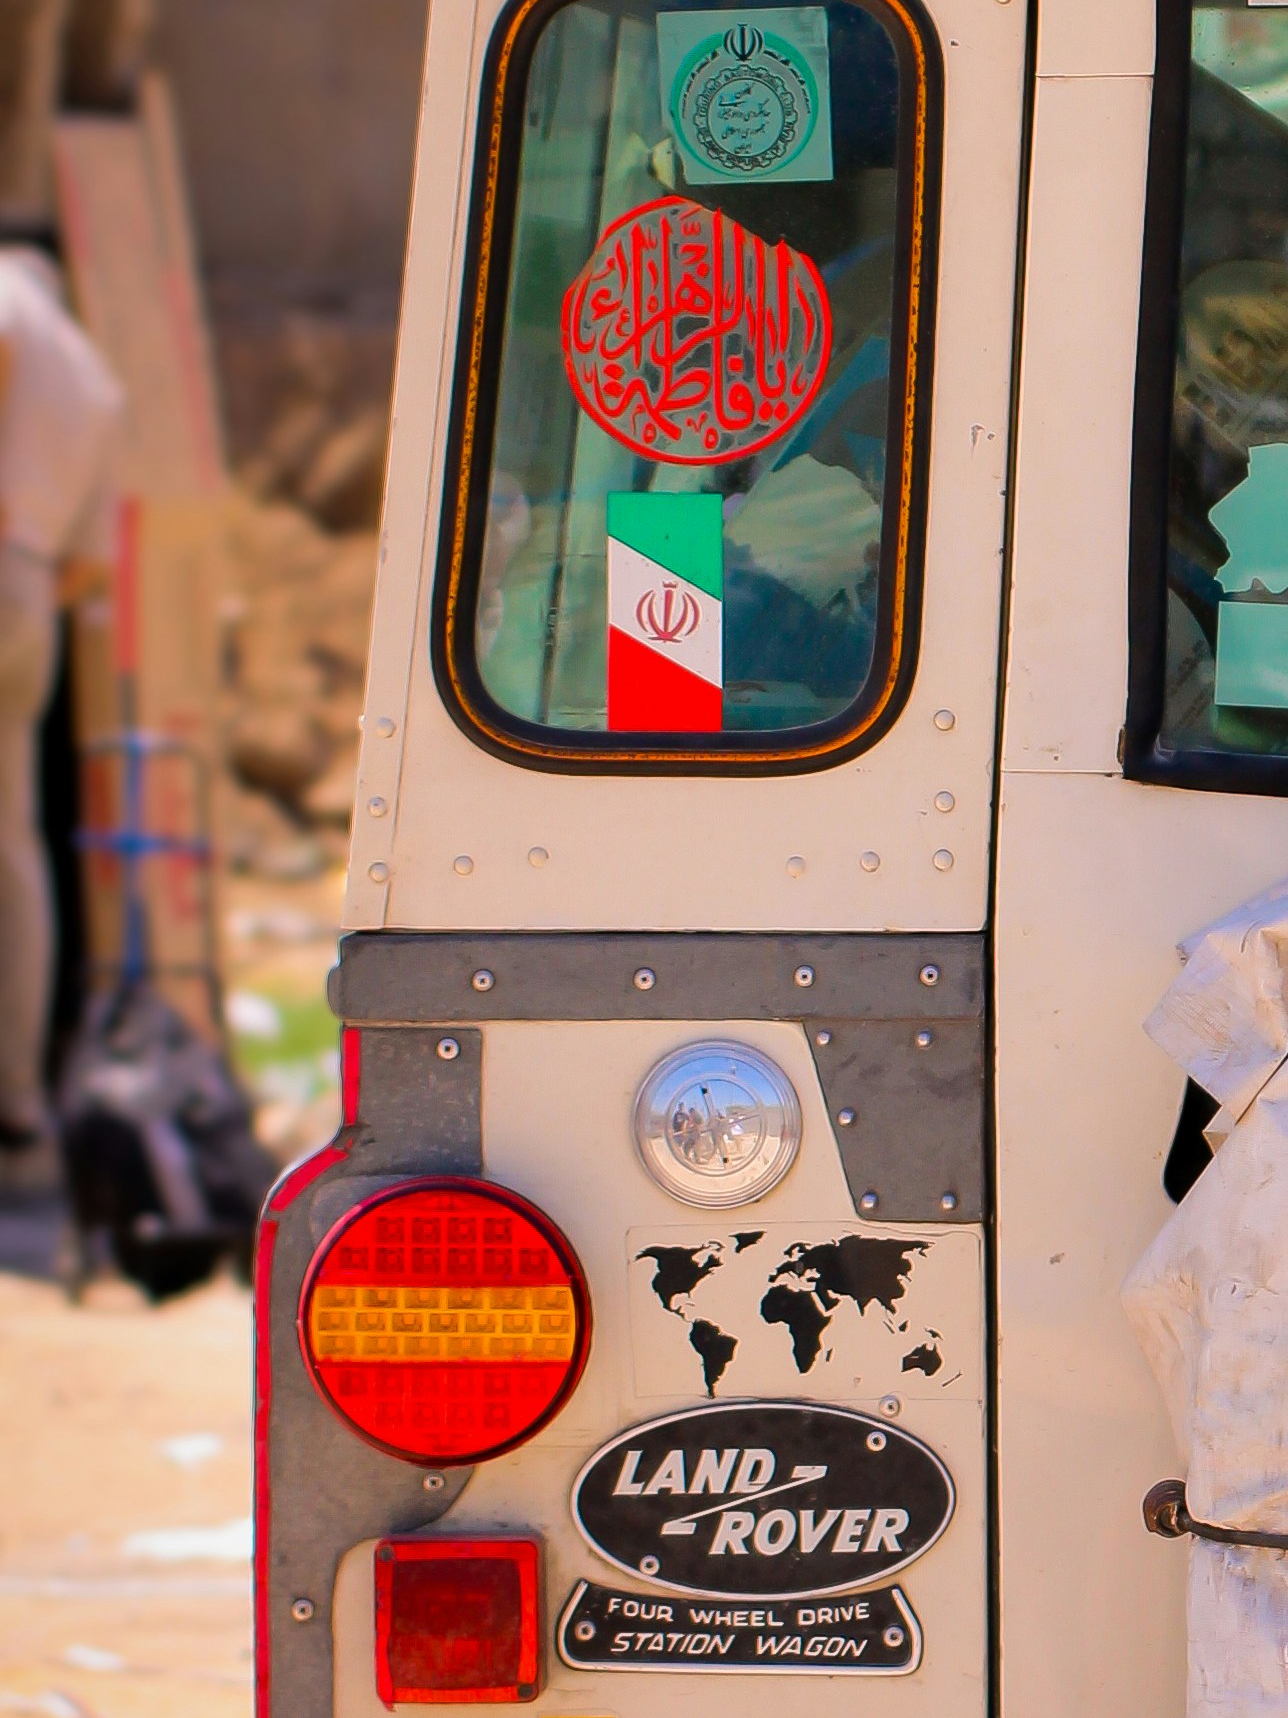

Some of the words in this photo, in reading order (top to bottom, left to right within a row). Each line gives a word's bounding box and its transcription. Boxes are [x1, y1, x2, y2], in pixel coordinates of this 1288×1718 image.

[612, 1448, 776, 1496] LAND
[708, 1508, 911, 1556] ROVER
[607, 1597, 674, 1623] FOUR
[689, 1608, 784, 1627] WHEEL
[797, 1602, 871, 1627] DRIVE
[610, 1632, 735, 1654] STATION
[756, 1635, 869, 1658] WAGON
